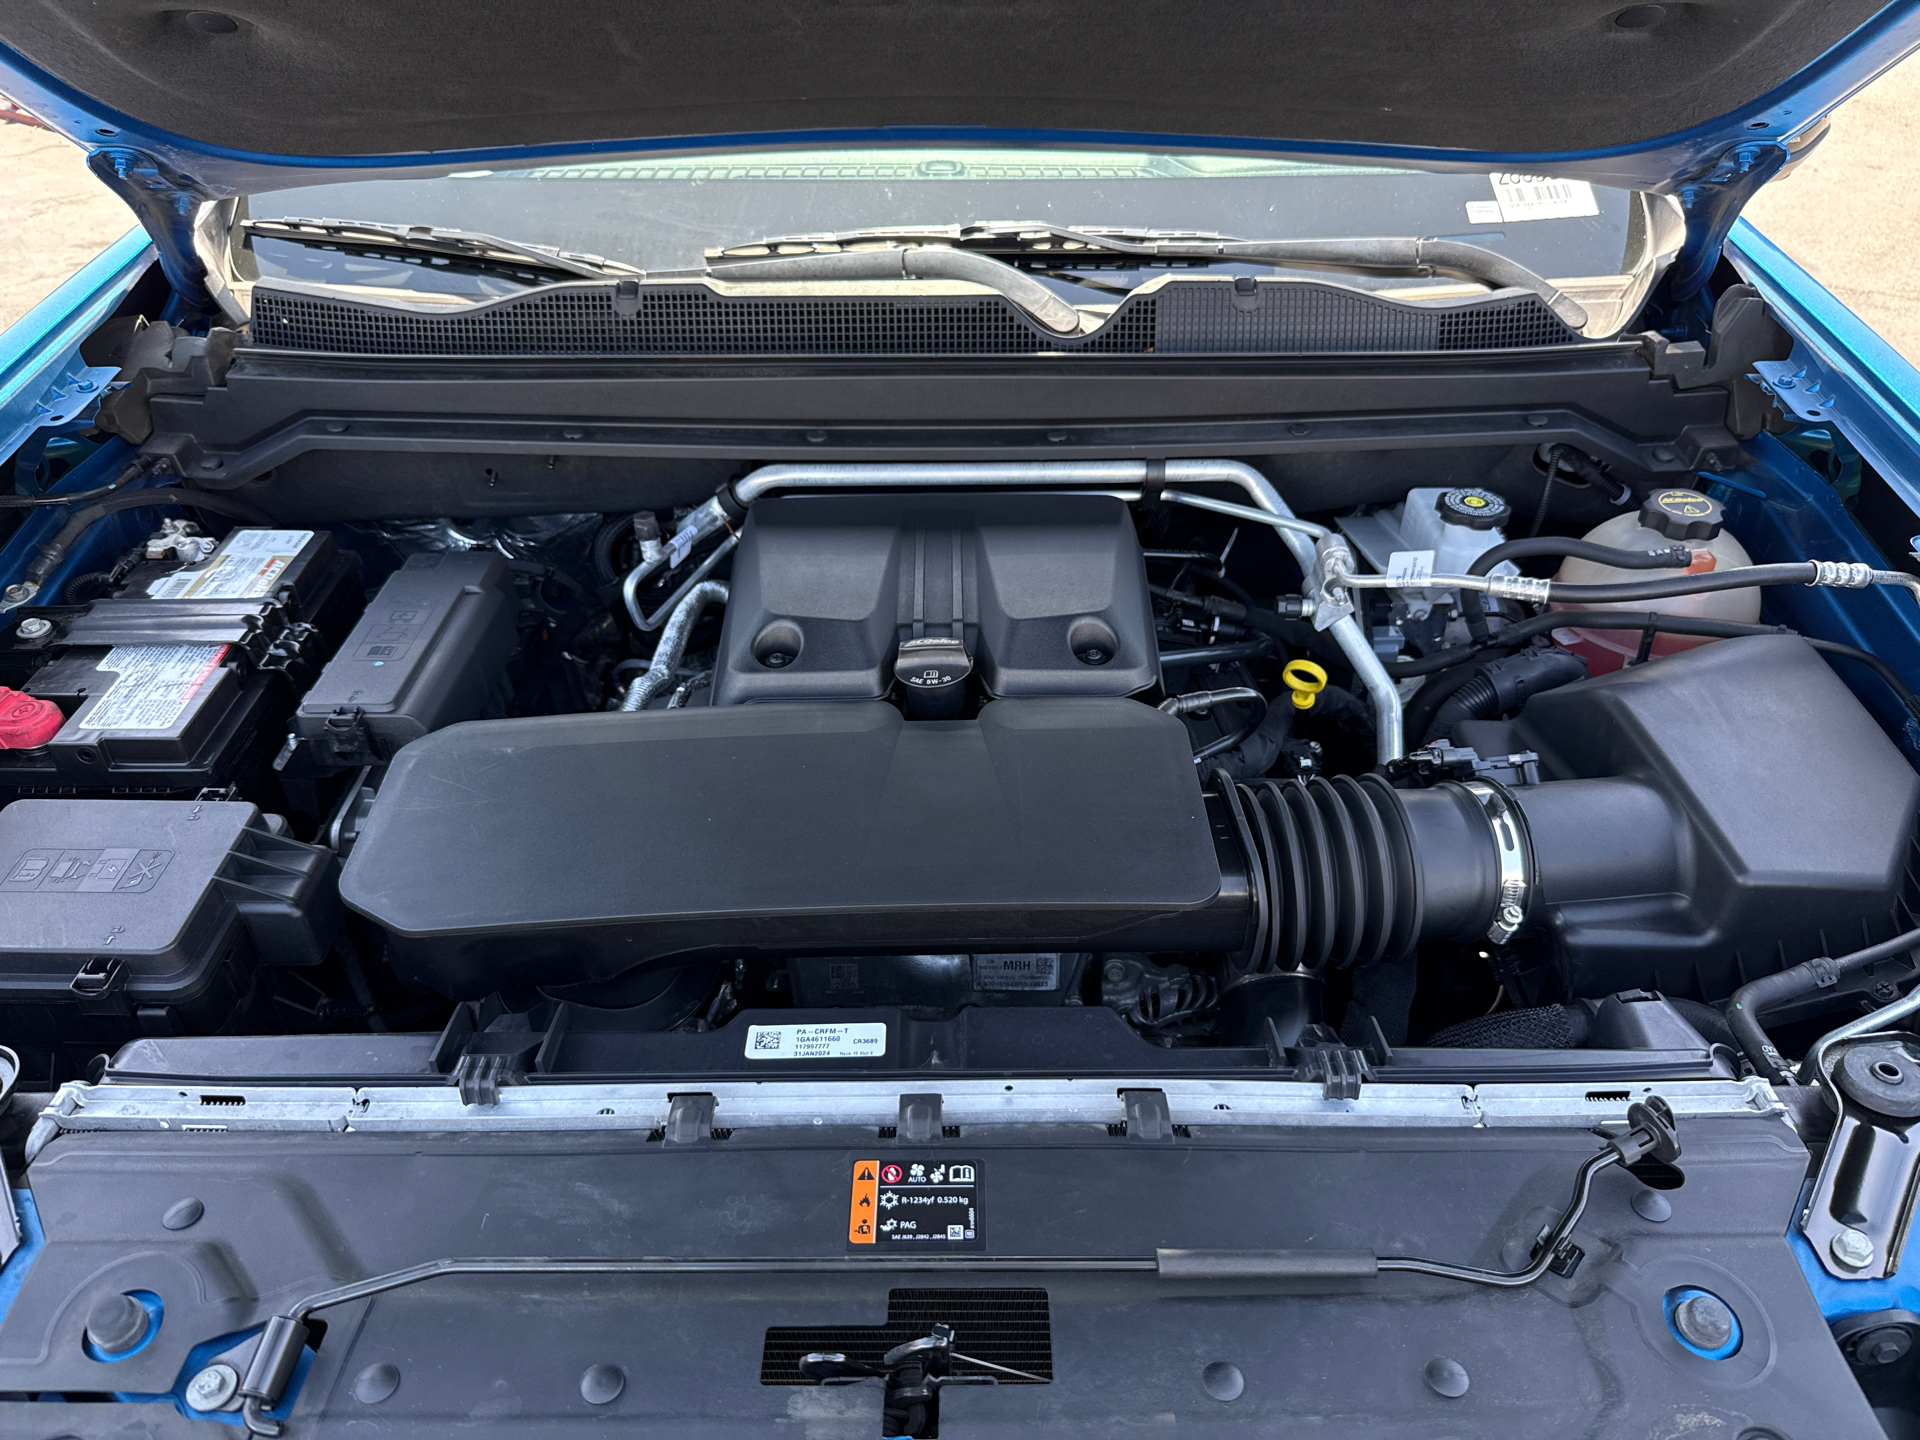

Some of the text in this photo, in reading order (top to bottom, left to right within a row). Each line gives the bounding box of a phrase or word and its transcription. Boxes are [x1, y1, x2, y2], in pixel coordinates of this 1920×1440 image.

[904, 638, 960, 648] ACDelco
[910, 676, 952, 684] SAE 5W-30
[1004, 961, 1030, 970] MRH
[901, 1196, 935, 1205] R-1234yf
[959, 1196, 969, 1205] kg
[900, 1221, 917, 1229] PAG
